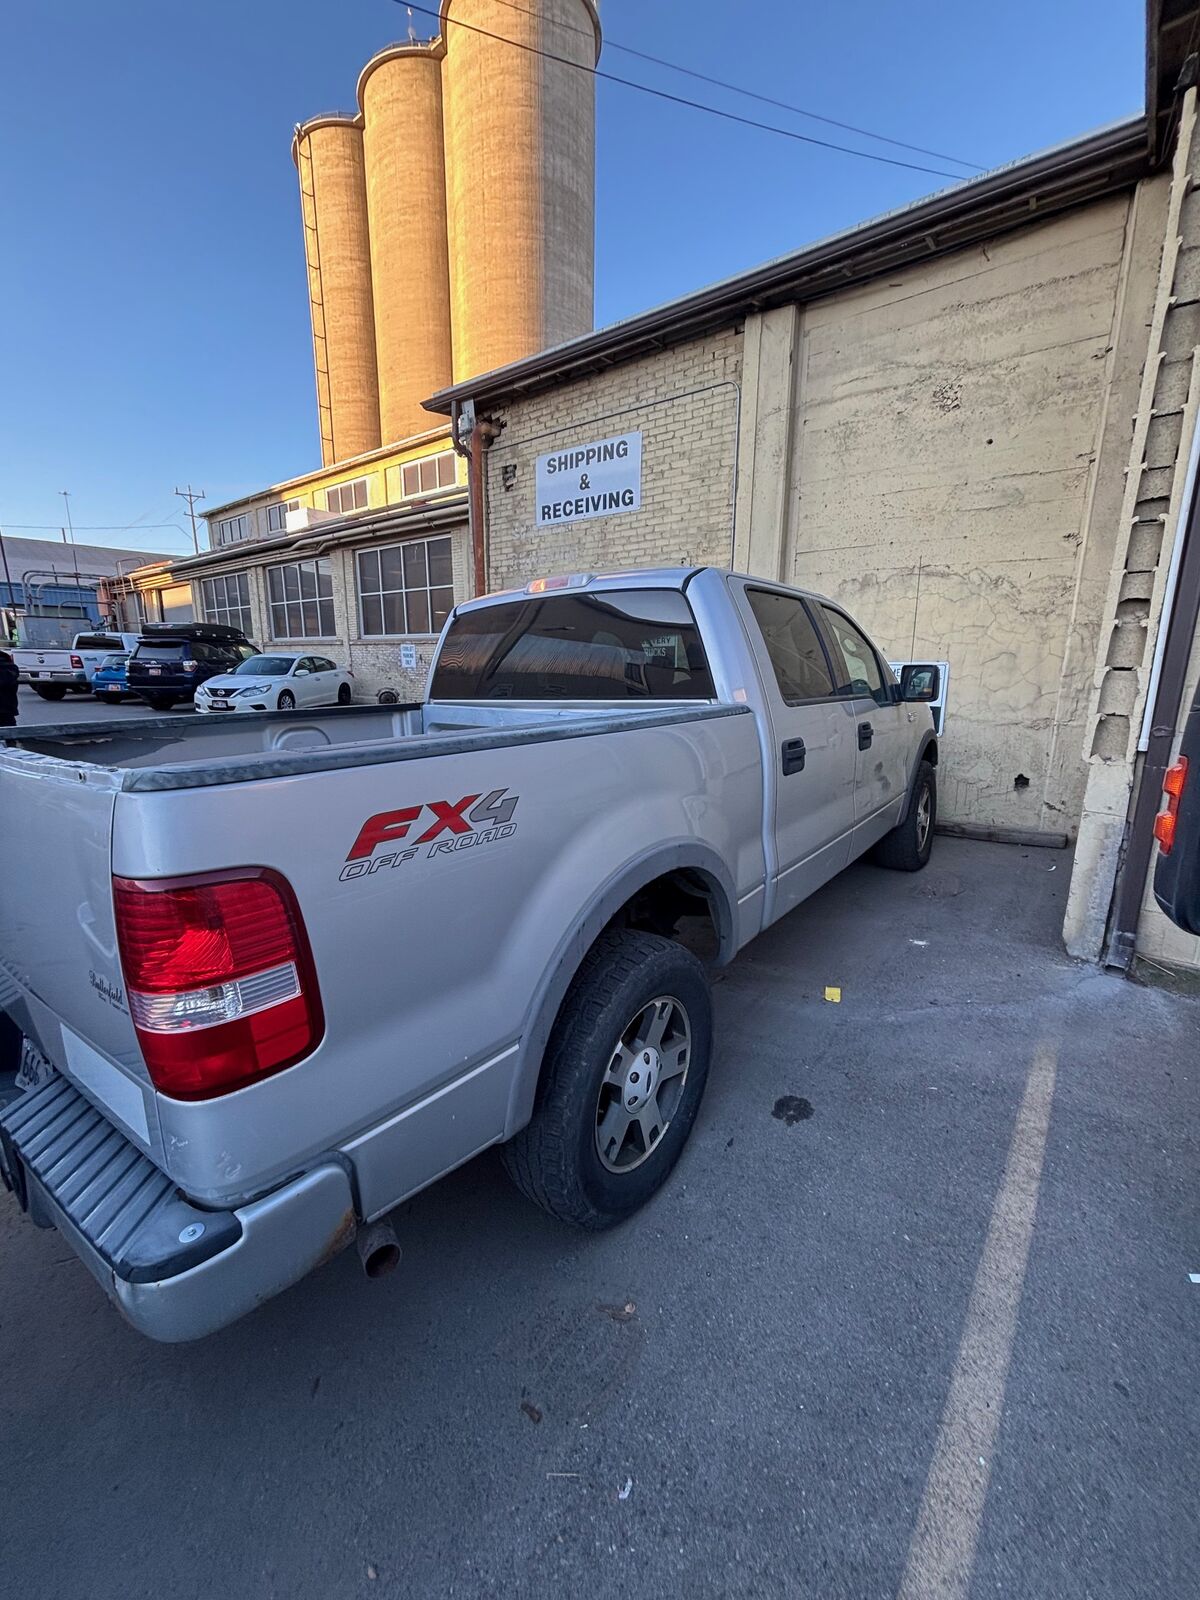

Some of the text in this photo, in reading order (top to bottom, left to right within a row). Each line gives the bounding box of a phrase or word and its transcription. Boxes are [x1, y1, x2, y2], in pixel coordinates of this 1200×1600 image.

[547, 440, 628, 474] SHIPPING
[579, 473, 591, 490] &
[541, 489, 634, 520] RECEIVING
[345, 788, 520, 862] FX4
[338, 823, 517, 882] OFF ROAD
